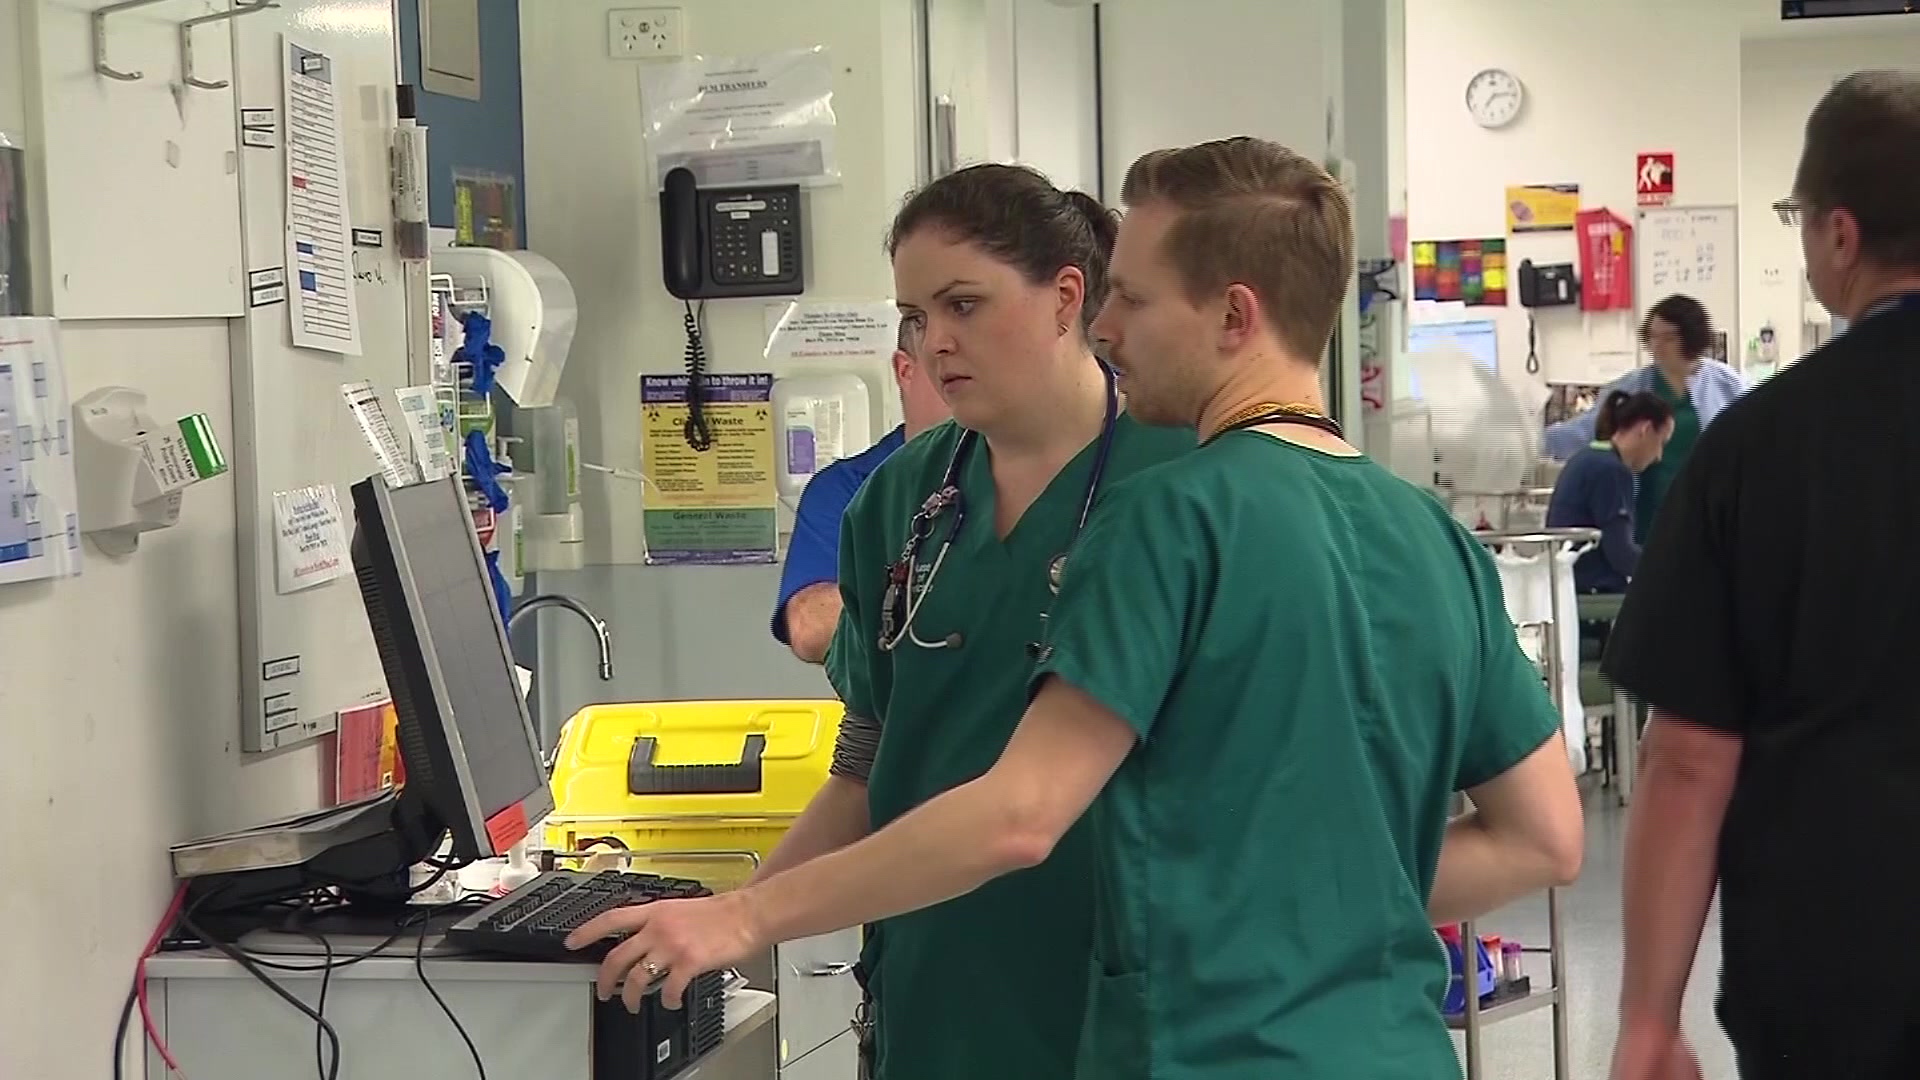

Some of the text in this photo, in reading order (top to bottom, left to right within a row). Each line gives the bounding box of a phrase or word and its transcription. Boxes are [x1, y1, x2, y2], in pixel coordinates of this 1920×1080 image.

[646, 377, 669, 387] Know
[671, 377, 690, 387] whic
[711, 377, 720, 386] to
[722, 376, 747, 386] throw
[748, 375, 755, 385] it
[711, 417, 744, 426] Waste
[673, 512, 747, 520] General Waste
